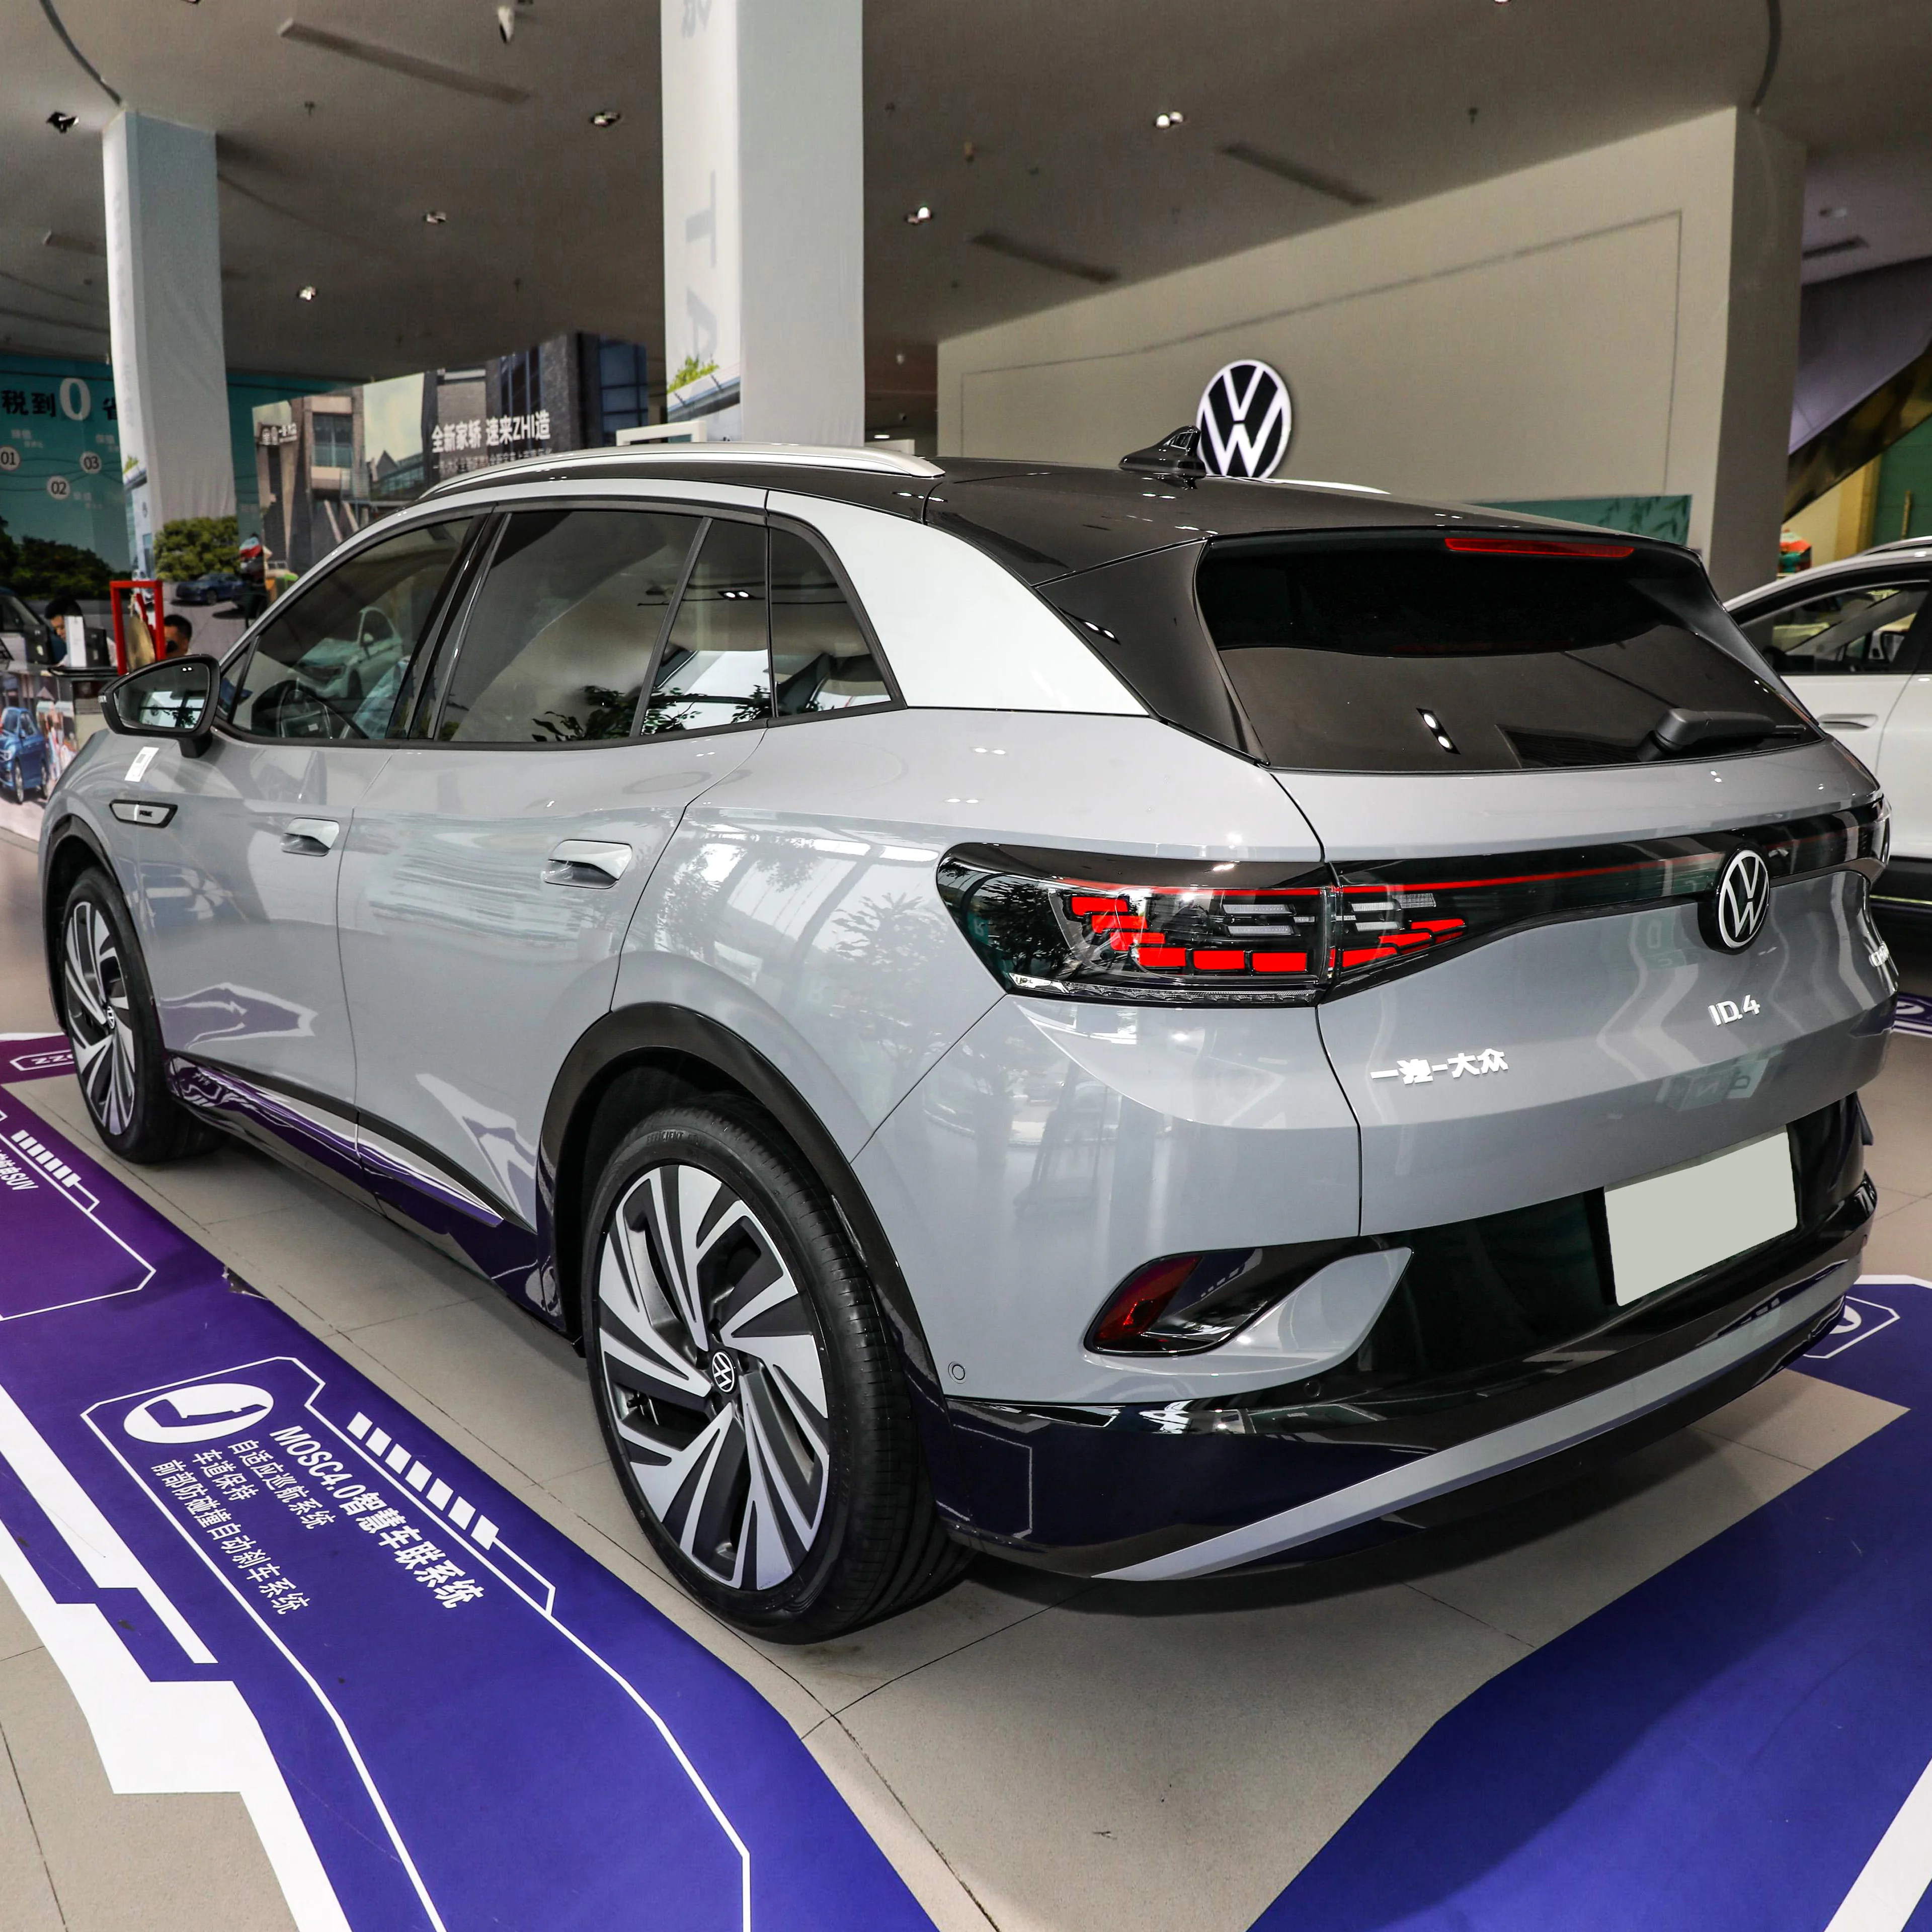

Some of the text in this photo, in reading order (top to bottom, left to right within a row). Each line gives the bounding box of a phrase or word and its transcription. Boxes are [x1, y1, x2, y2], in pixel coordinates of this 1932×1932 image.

[1, 451, 16, 465] 01
[84, 456, 99, 470] 03
[51, 481, 67, 495] 02
[1708, 994, 1761, 1026] ID.4
[31, 1053, 73, 1065] ZZ
[1370, 1048, 1509, 1085] 一汽-大众
[192, 1448, 259, 1501] 车道保持
[227, 1439, 337, 1530] 自适应巡航系统
[269, 1424, 485, 1609] MOSC4.0智慧车联系统
[150, 1459, 311, 1615] 前部防碰撞自动刹车系统
